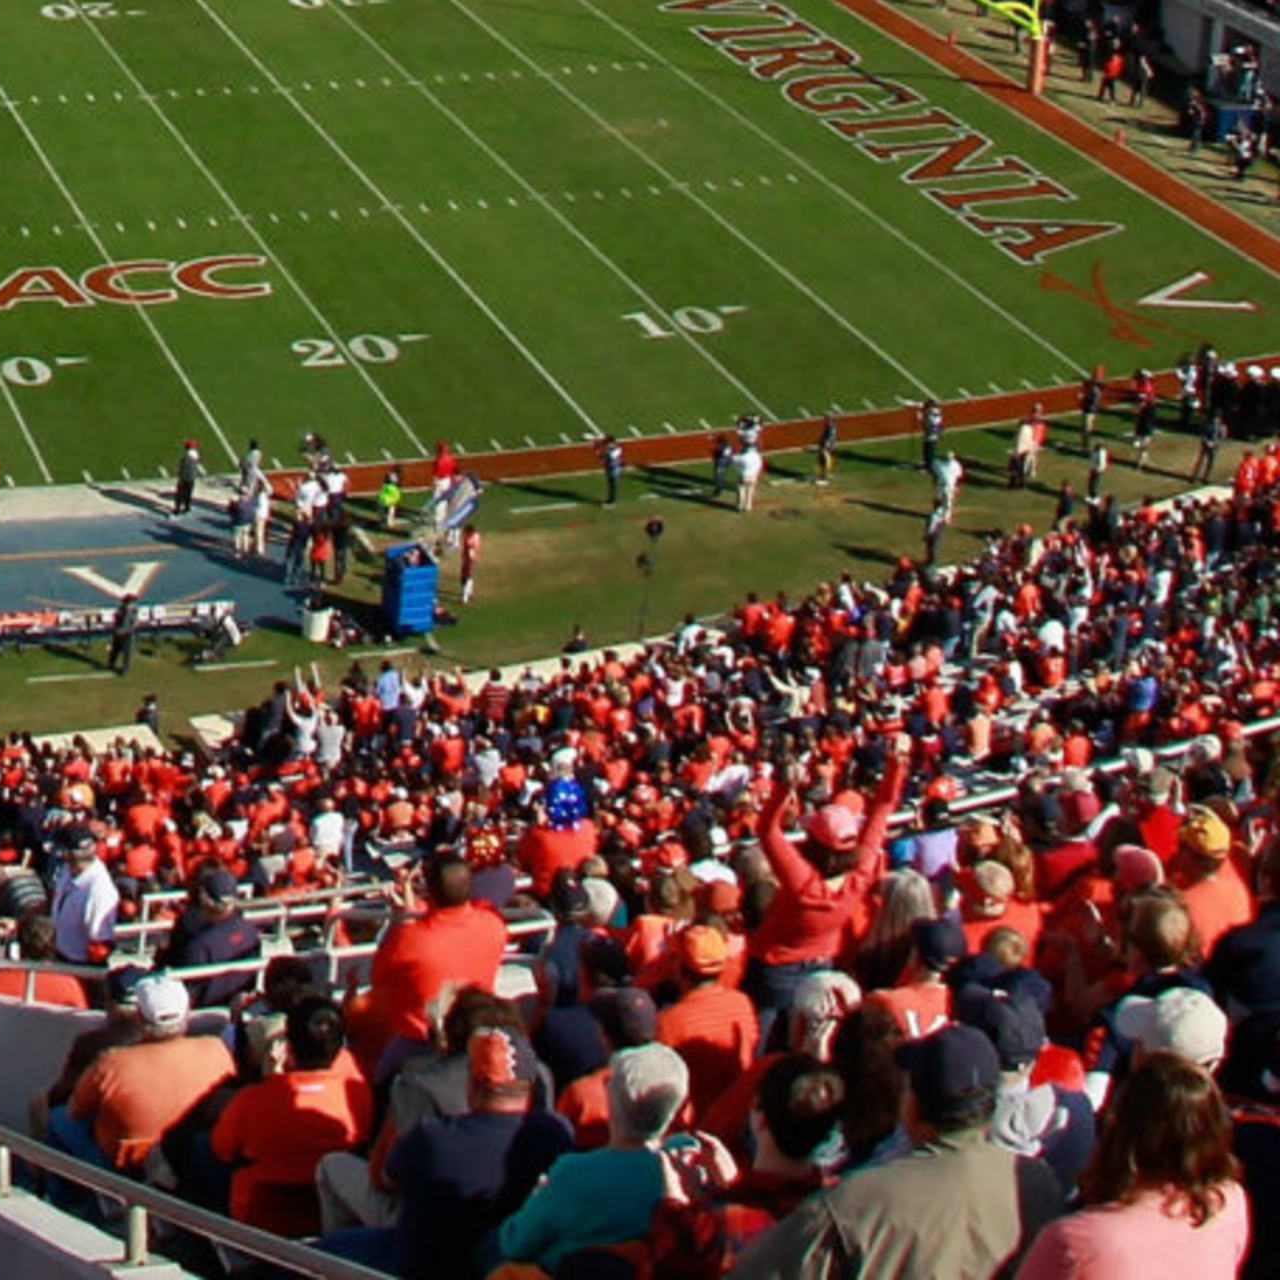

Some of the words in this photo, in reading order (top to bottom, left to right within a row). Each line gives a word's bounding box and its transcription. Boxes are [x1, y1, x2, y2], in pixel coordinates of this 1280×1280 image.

[42, 2, 116, 19] 20
[624, 308, 723, 338] 10
[291, 334, 399, 367] 20
